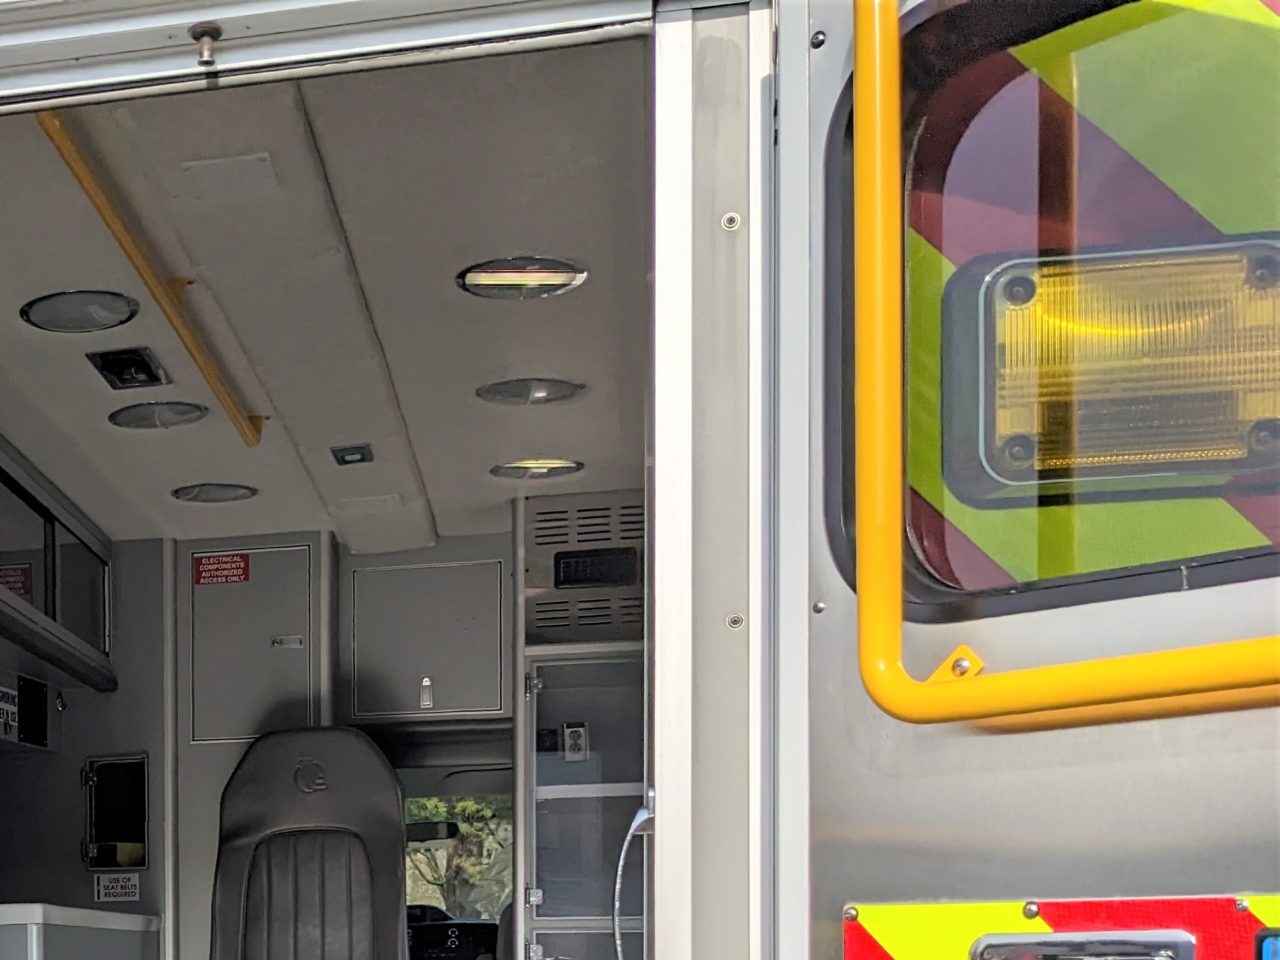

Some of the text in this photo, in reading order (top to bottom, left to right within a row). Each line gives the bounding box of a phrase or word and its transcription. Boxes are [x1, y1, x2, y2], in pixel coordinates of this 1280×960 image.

[202, 556, 242, 564] ELECTRICAL
[200, 562, 244, 571] COMPONENTS
[201, 569, 243, 577] AUTHORIZED
